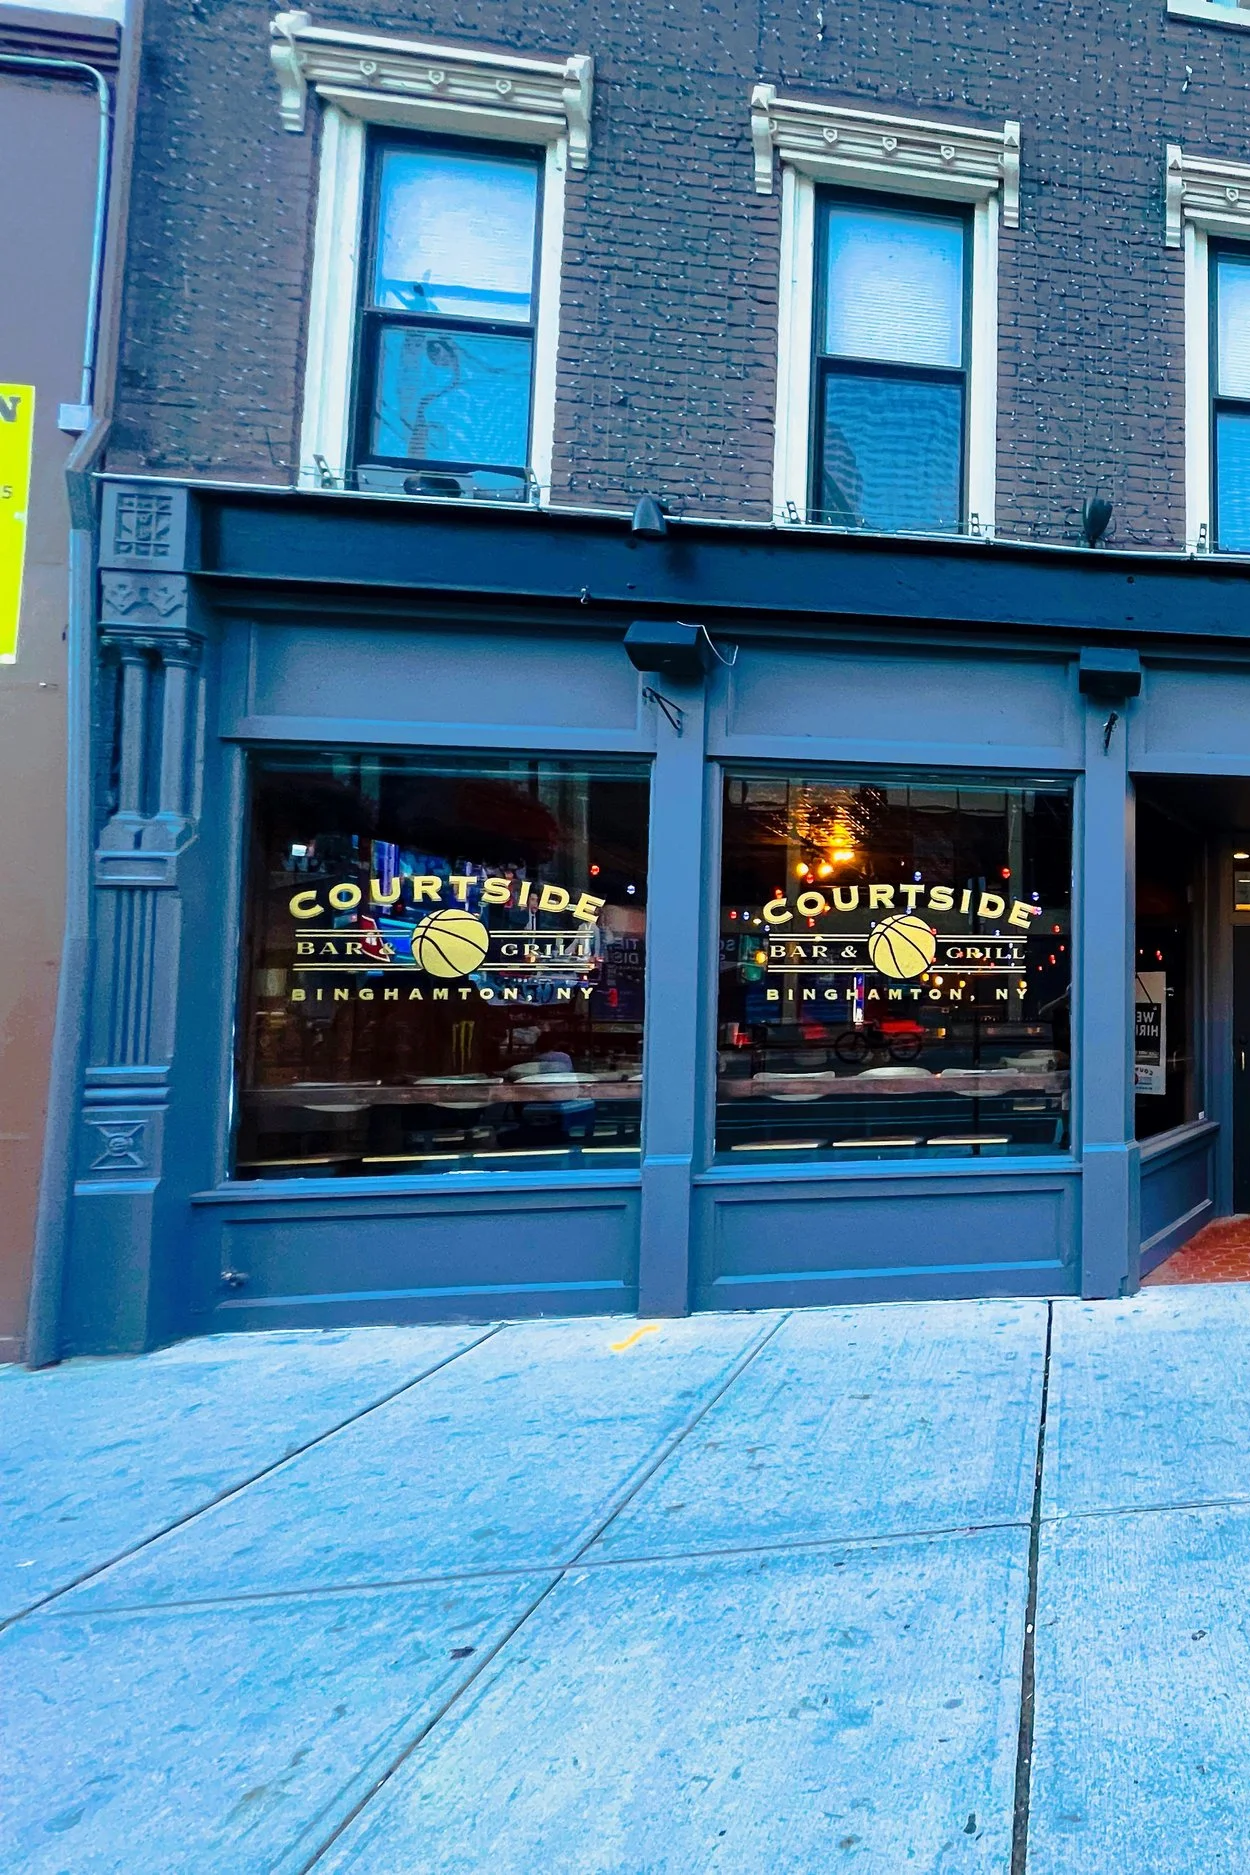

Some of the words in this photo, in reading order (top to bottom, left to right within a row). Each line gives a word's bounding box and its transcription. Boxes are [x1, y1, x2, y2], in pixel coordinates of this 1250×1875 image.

[289, 875, 606, 924] COURTSIDE
[763, 884, 1036, 929] COURTSIDE
[296, 942, 363, 955] BAR
[379, 943, 395, 955] &
[501, 943, 590, 956] GRILL
[770, 945, 828, 958] BAR
[841, 946, 857, 958] &
[946, 947, 1026, 960] GRILL
[291, 987, 532, 1002] BINGHAMTON,
[557, 987, 594, 1000] NY
[767, 988, 975, 1002] BINGHAMTON,
[996, 988, 1028, 1000] NY
